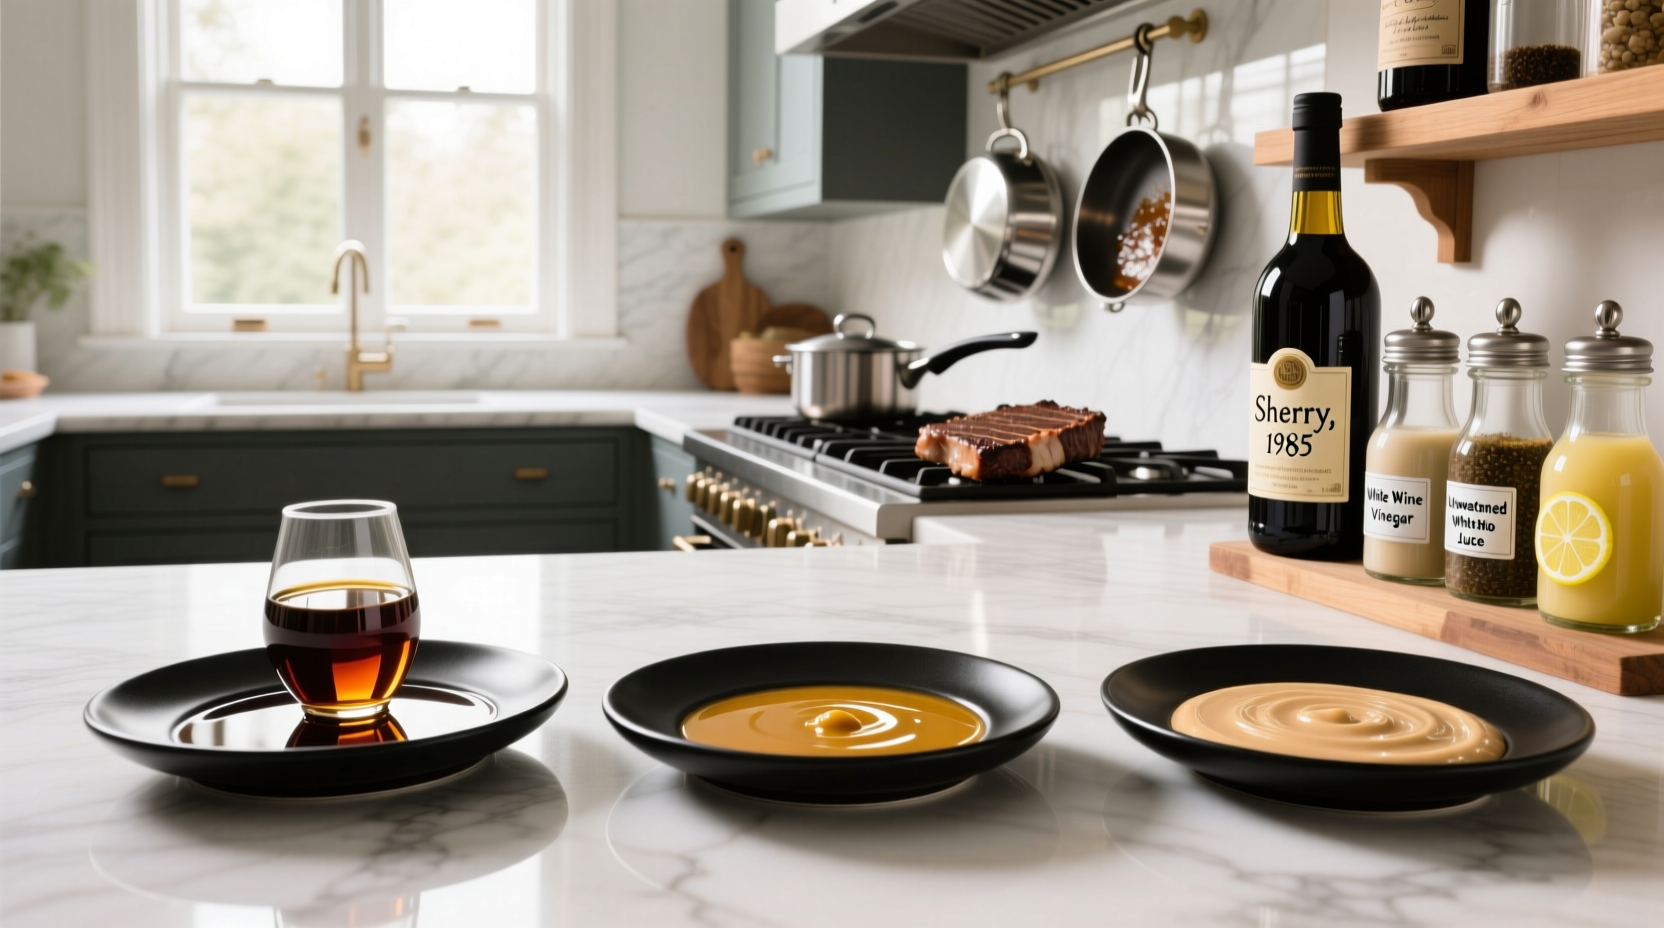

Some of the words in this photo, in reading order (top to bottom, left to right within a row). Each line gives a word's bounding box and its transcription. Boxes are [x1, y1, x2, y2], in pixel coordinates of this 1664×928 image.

[1254, 394, 1335, 434] Sherry,
[1266, 432, 1313, 457] 1985
[1392, 490, 1423, 506] Wine
